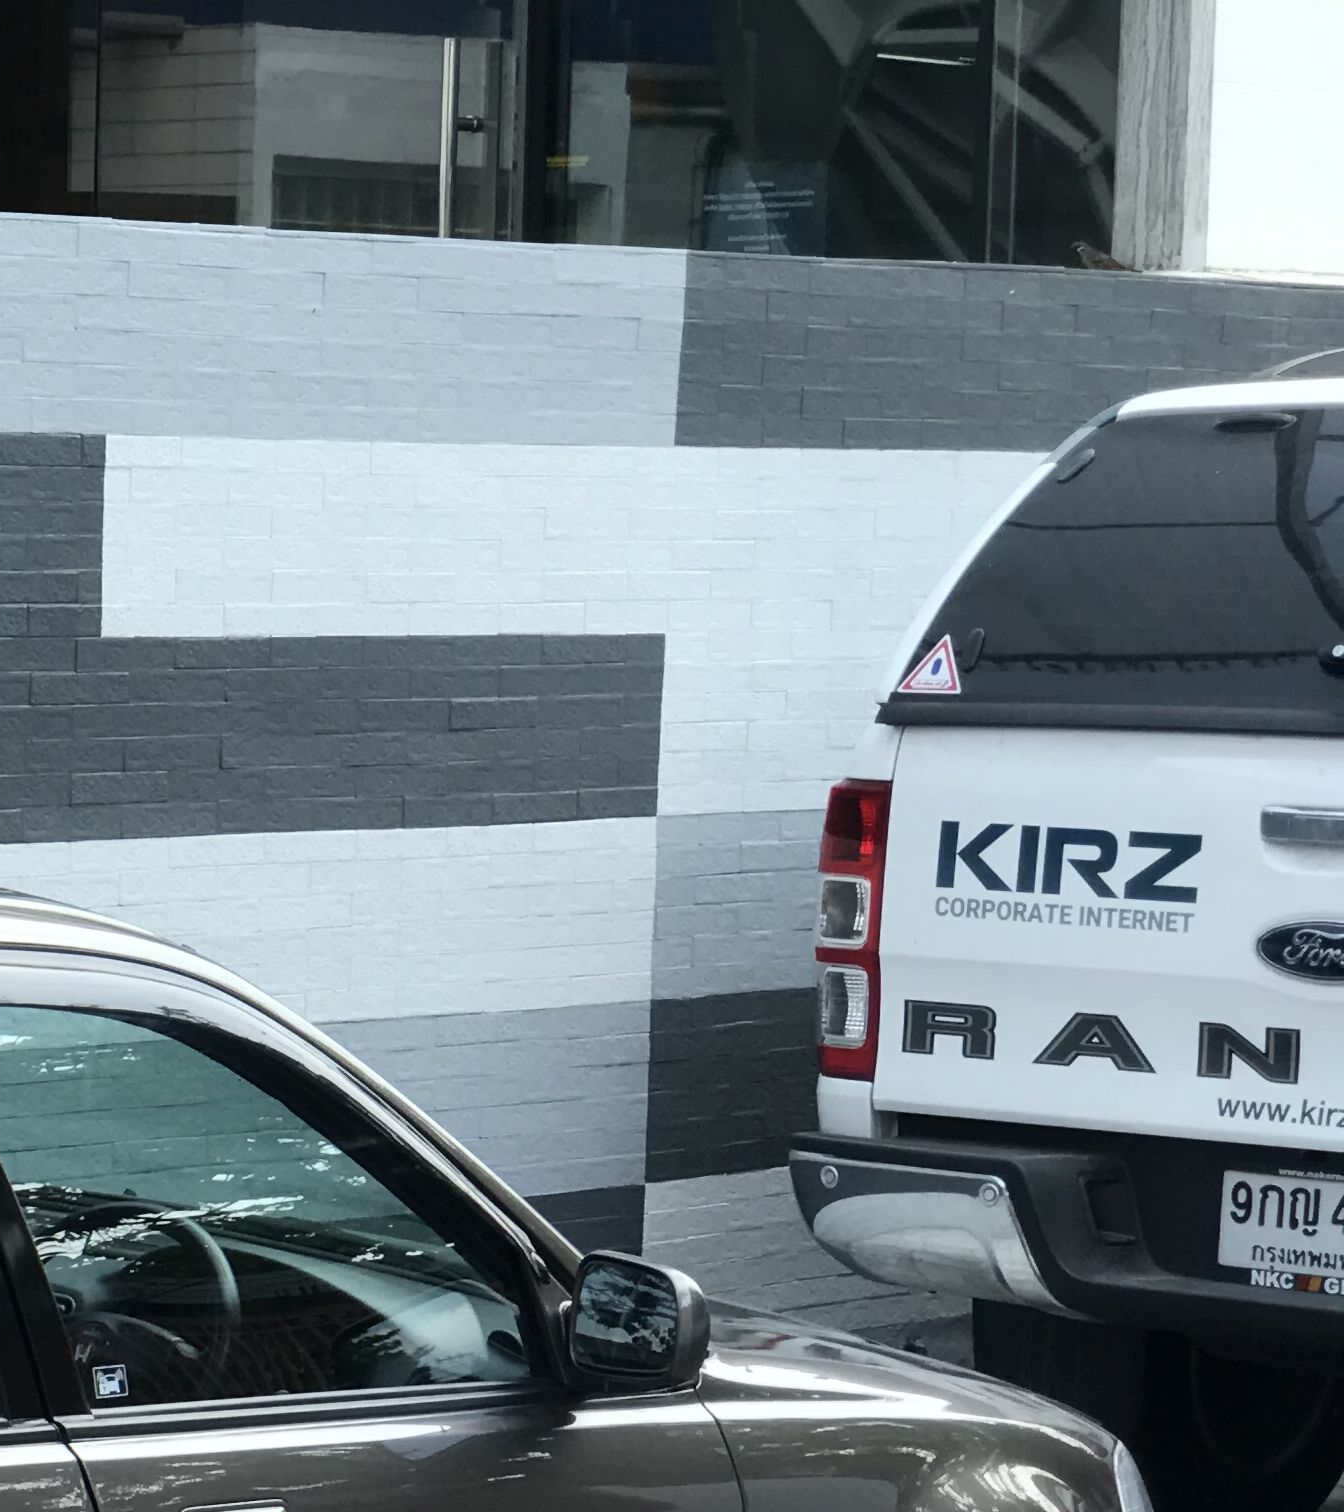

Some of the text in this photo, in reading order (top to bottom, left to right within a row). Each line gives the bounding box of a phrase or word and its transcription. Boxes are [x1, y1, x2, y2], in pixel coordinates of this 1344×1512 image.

[935, 820, 1203, 904] KIRZ
[934, 896, 1194, 934] CORPORATE INTERNET
[1250, 1269, 1295, 1290] NKC
